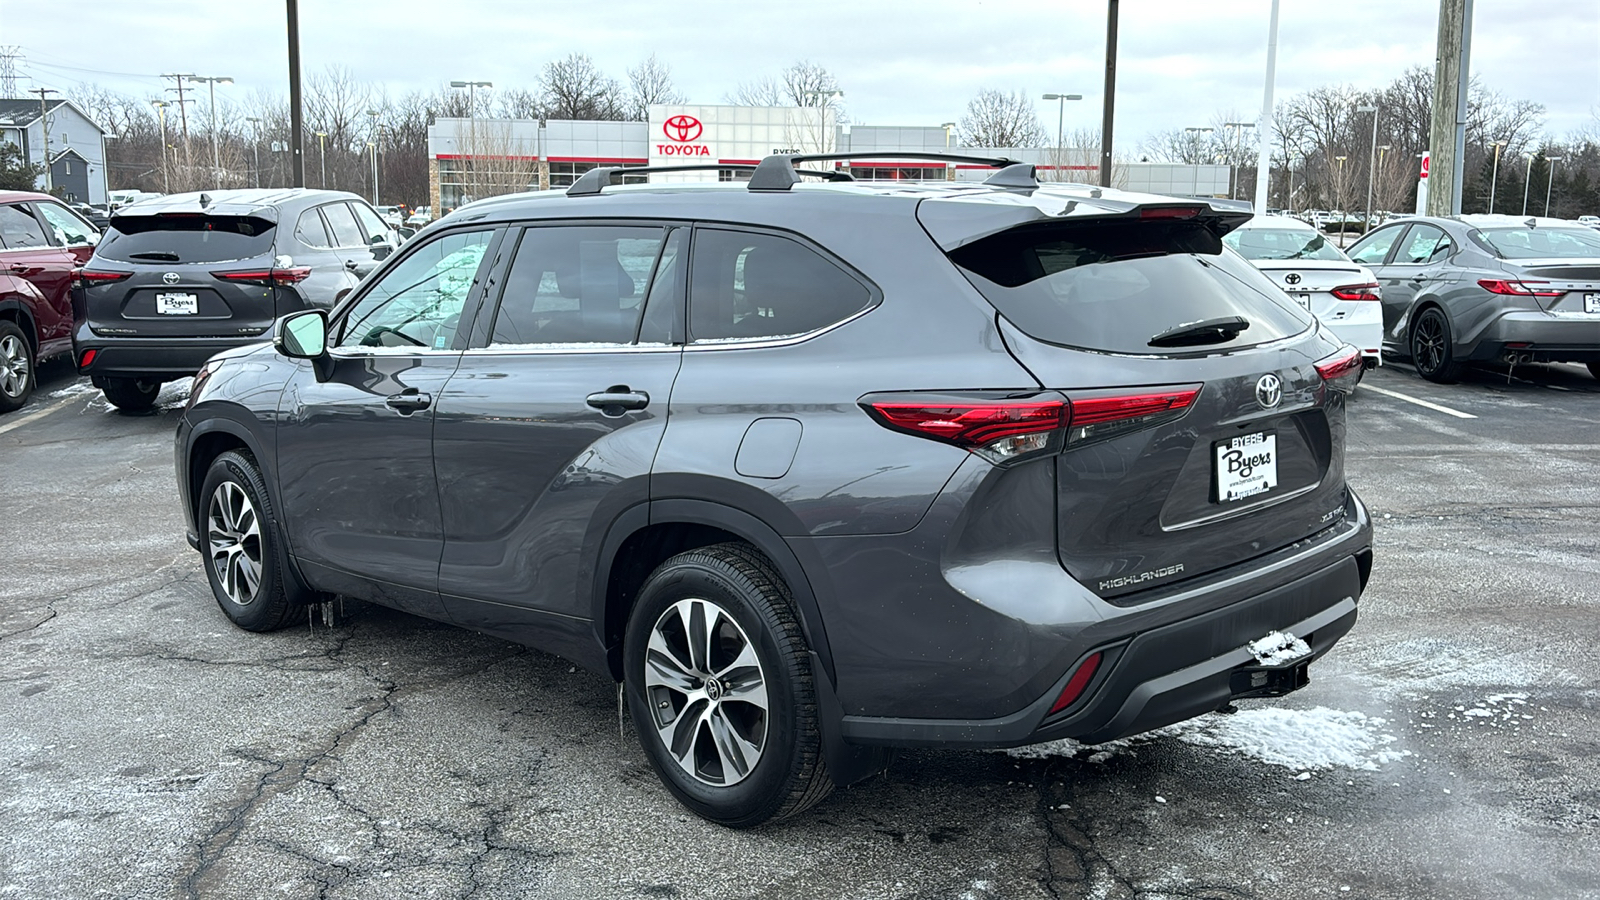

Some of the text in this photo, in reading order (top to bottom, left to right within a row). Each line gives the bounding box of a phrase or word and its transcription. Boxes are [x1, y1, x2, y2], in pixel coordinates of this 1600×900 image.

[656, 144, 710, 156] TOYOTA
[1232, 432, 1263, 448] BYERS
[1222, 450, 1271, 478] Byers
[1099, 563, 1185, 590] HIGHLANDER
